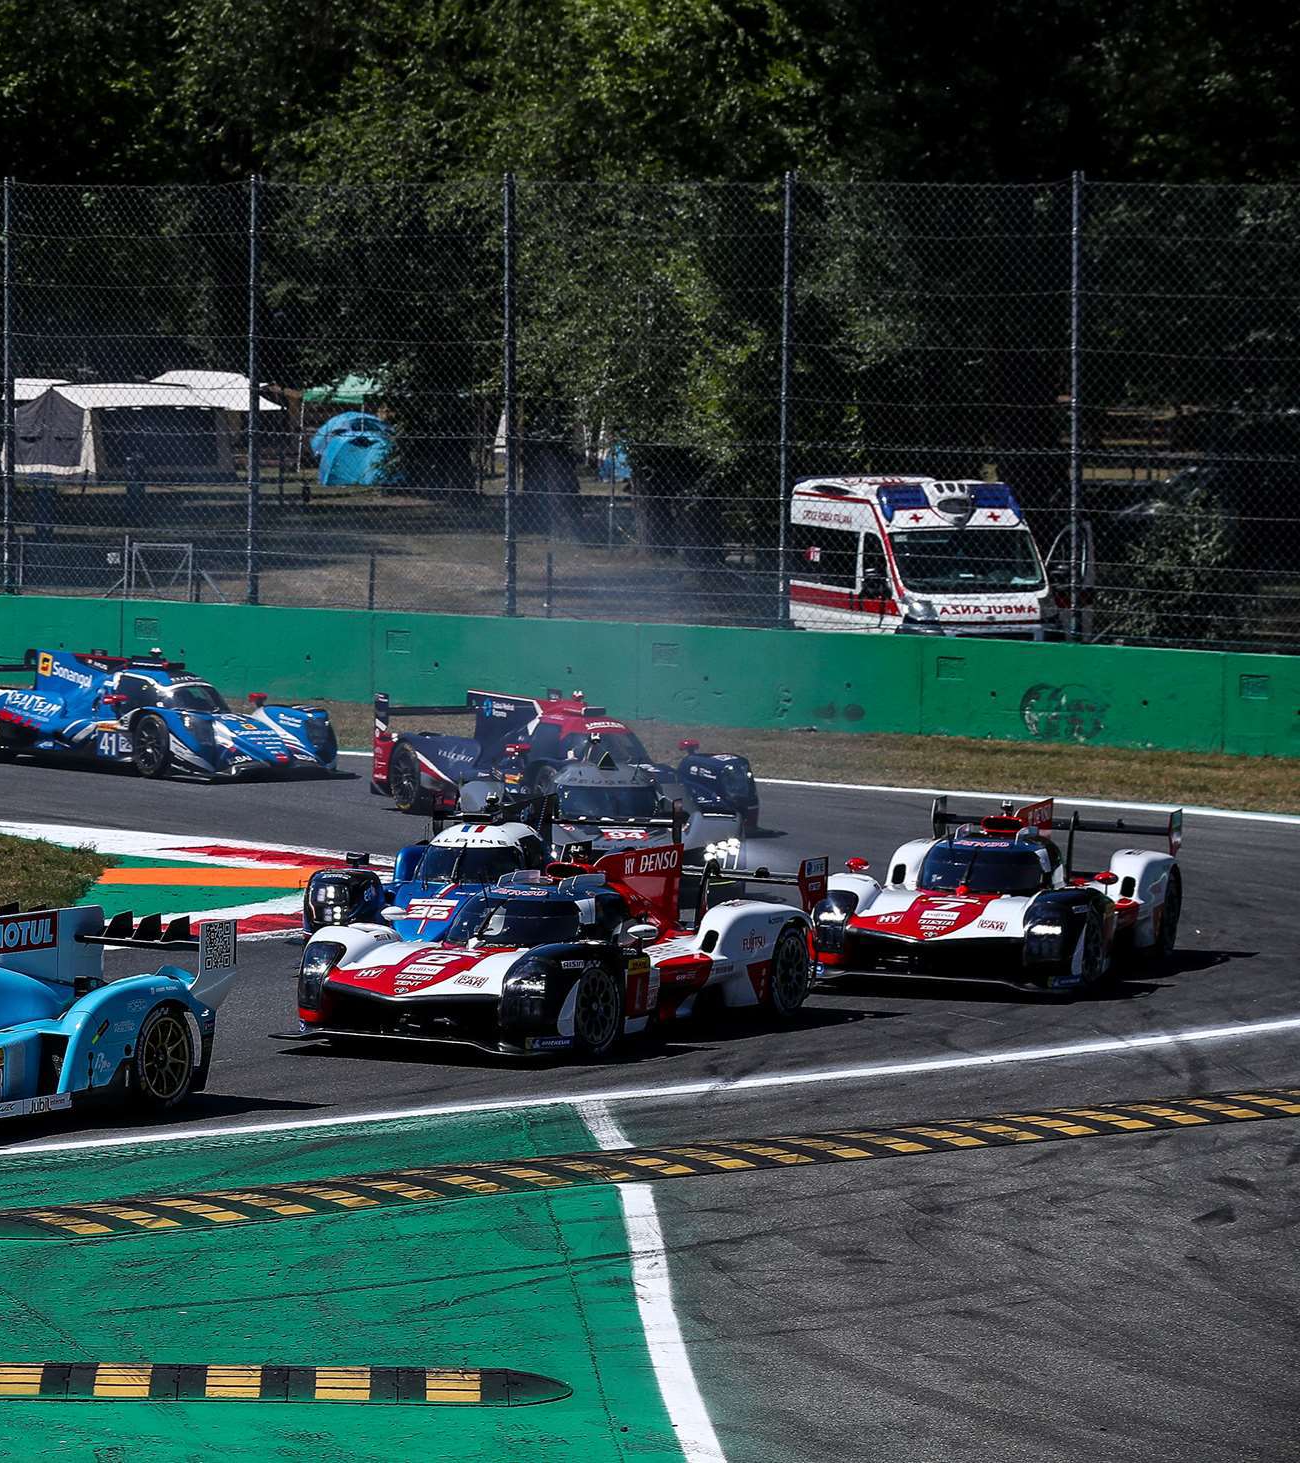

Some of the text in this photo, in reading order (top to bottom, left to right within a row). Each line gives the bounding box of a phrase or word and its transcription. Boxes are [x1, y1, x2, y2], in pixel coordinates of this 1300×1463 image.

[52, 662, 93, 689] Sonangol
[99, 732, 116, 756] 41
[608, 831, 644, 840] 94
[624, 850, 678, 874] HY DENSO
[931, 901, 966, 910] 7
[406, 905, 450, 919] 36
[879, 915, 901, 923] HY
[416, 954, 462, 964] 8
[357, 969, 381, 977] HY
[457, 979, 483, 988] CAR
